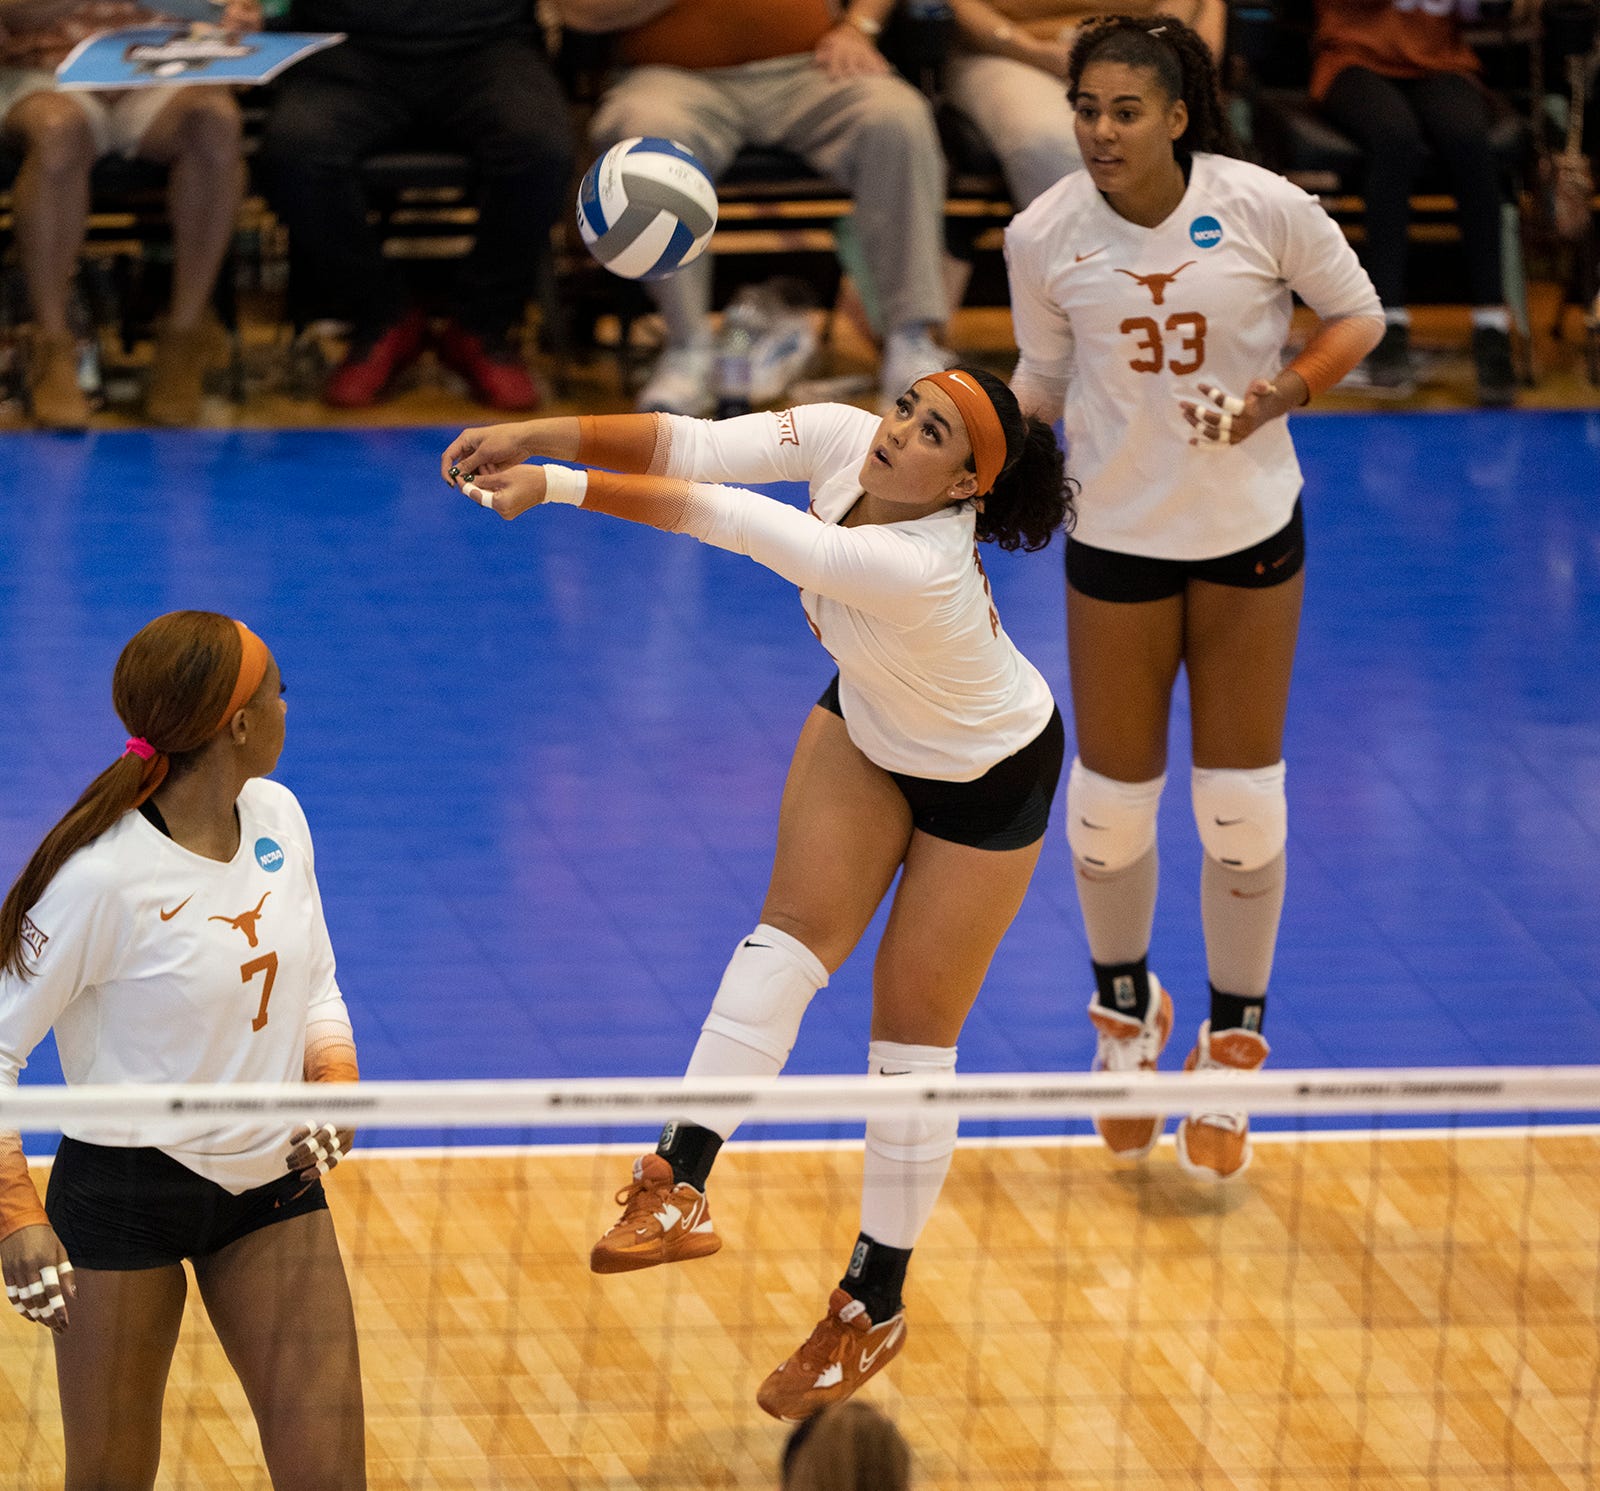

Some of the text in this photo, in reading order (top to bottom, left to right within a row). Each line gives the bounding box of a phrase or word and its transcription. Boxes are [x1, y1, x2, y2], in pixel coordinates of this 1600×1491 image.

[1120, 312, 1207, 375] 33
[260, 849, 283, 867] NCAA
[240, 951, 278, 1032] 7
